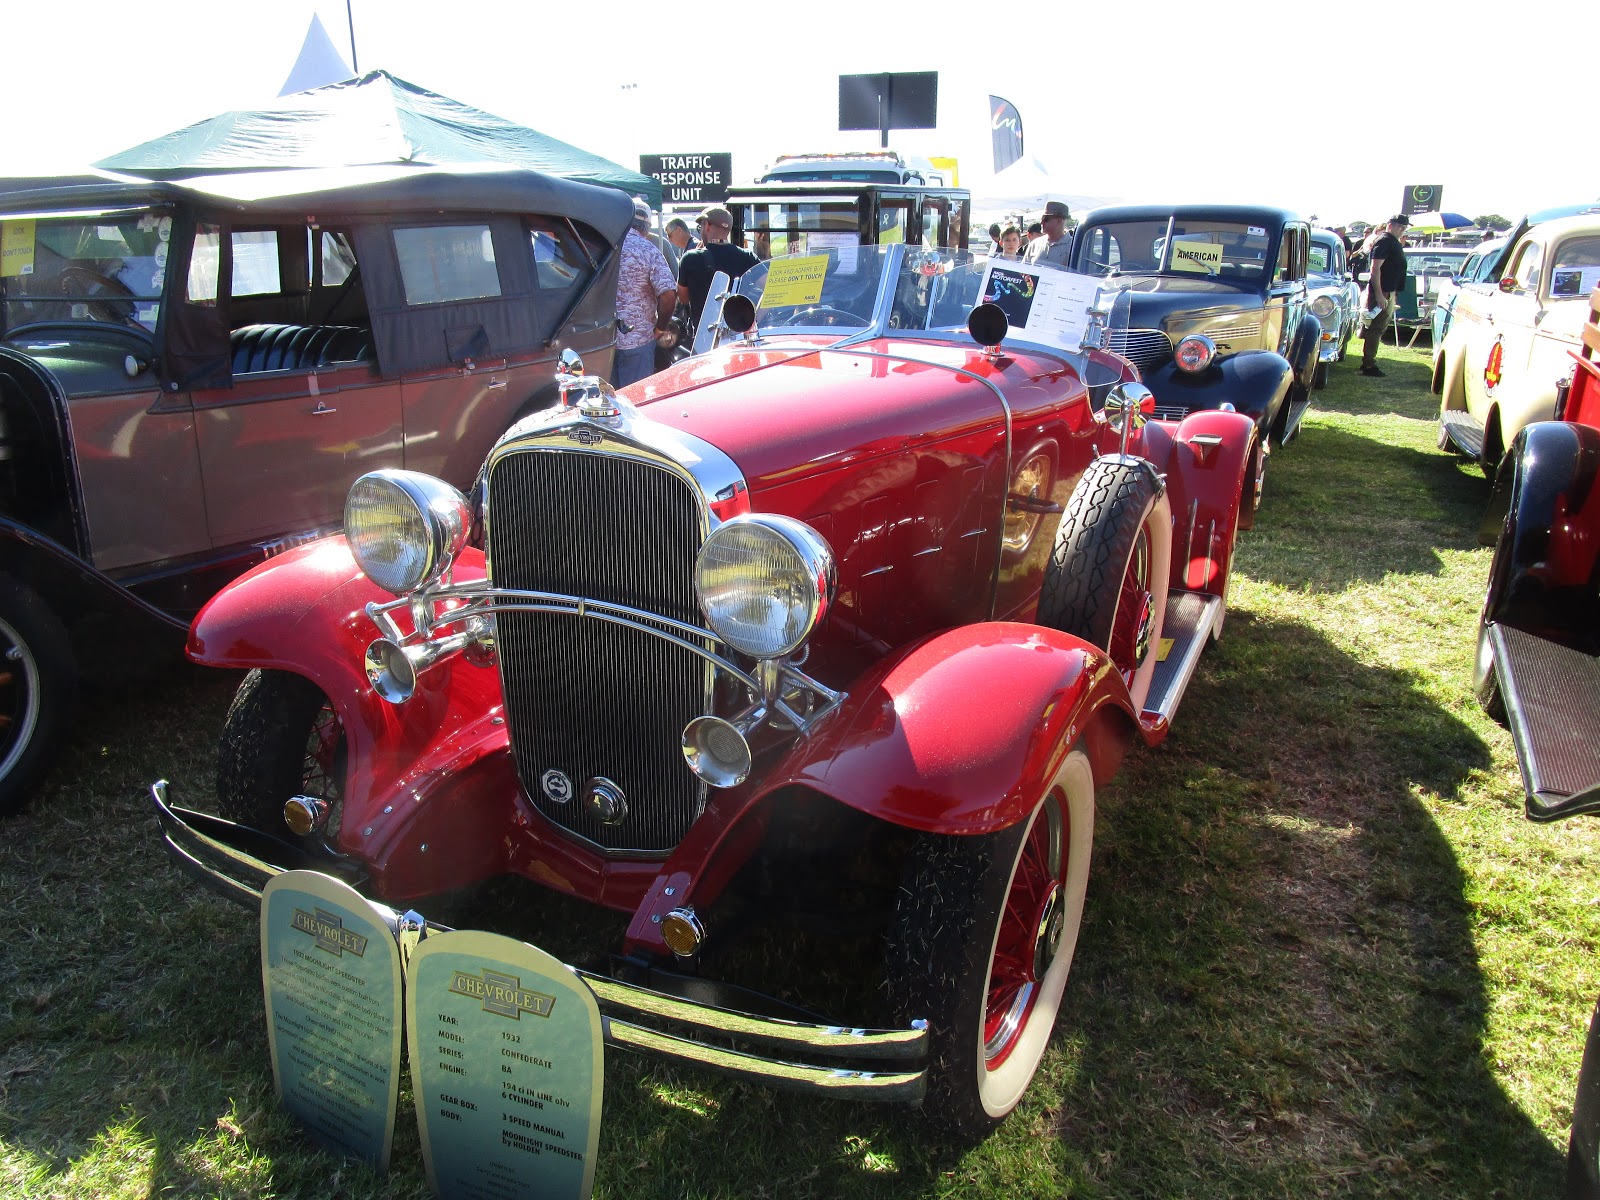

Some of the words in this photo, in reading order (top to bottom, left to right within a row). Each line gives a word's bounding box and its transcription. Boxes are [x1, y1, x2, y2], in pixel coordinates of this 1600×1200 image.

[660, 156, 712, 170] TRAFFIC
[652, 172, 720, 185] RESPONSE
[672, 188, 702, 200] UNIT
[1177, 250, 1218, 262] AMERICAN
[991, 274, 1023, 284] MOTORFEST
[297, 914, 358, 950] CHEVROLET
[304, 954, 334, 972] MOONLIGHT
[334, 968, 366, 986] SPEEDSTER
[457, 976, 544, 1012] CHEVROLET
[438, 1014, 458, 1026] YEAR:
[438, 1030, 464, 1044] MODEL:
[502, 1032, 520, 1043] 1932
[438, 1046, 464, 1060] SERIES:
[502, 1048, 552, 1069] CONFEDERATE
[440, 1062, 467, 1076] ENGINE:
[502, 1064, 512, 1074] BA
[502, 1082, 516, 1092] 194
[526, 1088, 535, 1098] IN
[537, 1092, 553, 1102] LINE
[555, 1098, 570, 1108] ohv
[508, 1094, 544, 1110] CYLINDER
[440, 1093, 458, 1106] GEAR
[460, 1099, 478, 1112] BOX:
[440, 1109, 462, 1122] BODY:
[502, 1112, 506, 1120] 3
[508, 1116, 531, 1128] SPEED
[533, 1123, 565, 1140] MANUAL
[502, 1130, 543, 1148] MOONLIGHT
[544, 1144, 582, 1162] SPEEDSTER
[502, 1136, 512, 1148] by
[513, 1141, 540, 1156] HOLDEN
